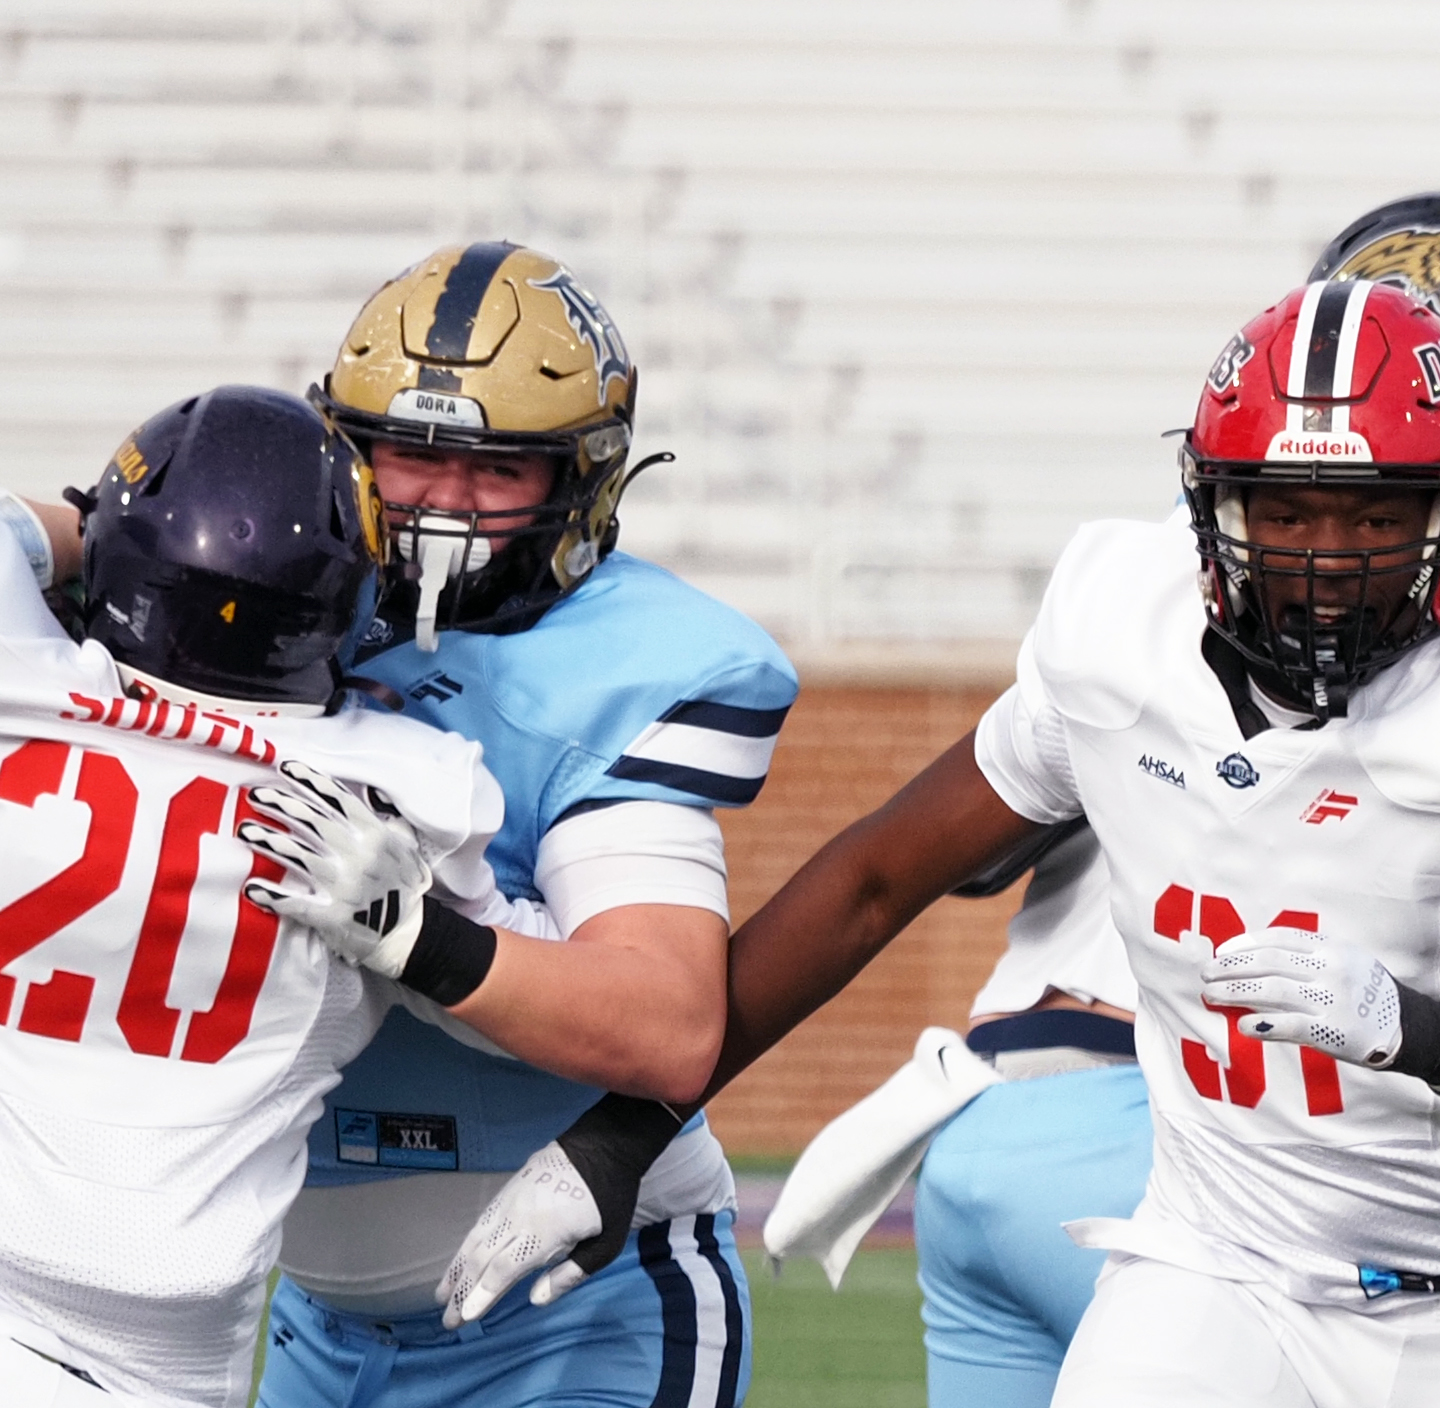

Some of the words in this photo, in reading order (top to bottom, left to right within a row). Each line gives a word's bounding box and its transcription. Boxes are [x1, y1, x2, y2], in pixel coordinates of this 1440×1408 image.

[415, 394, 457, 416] DORA
[220, 601, 236, 624] 4
[1138, 753, 1187, 789] AHSAA
[0, 737, 291, 1065] 20
[399, 1128, 438, 1150] XXL
